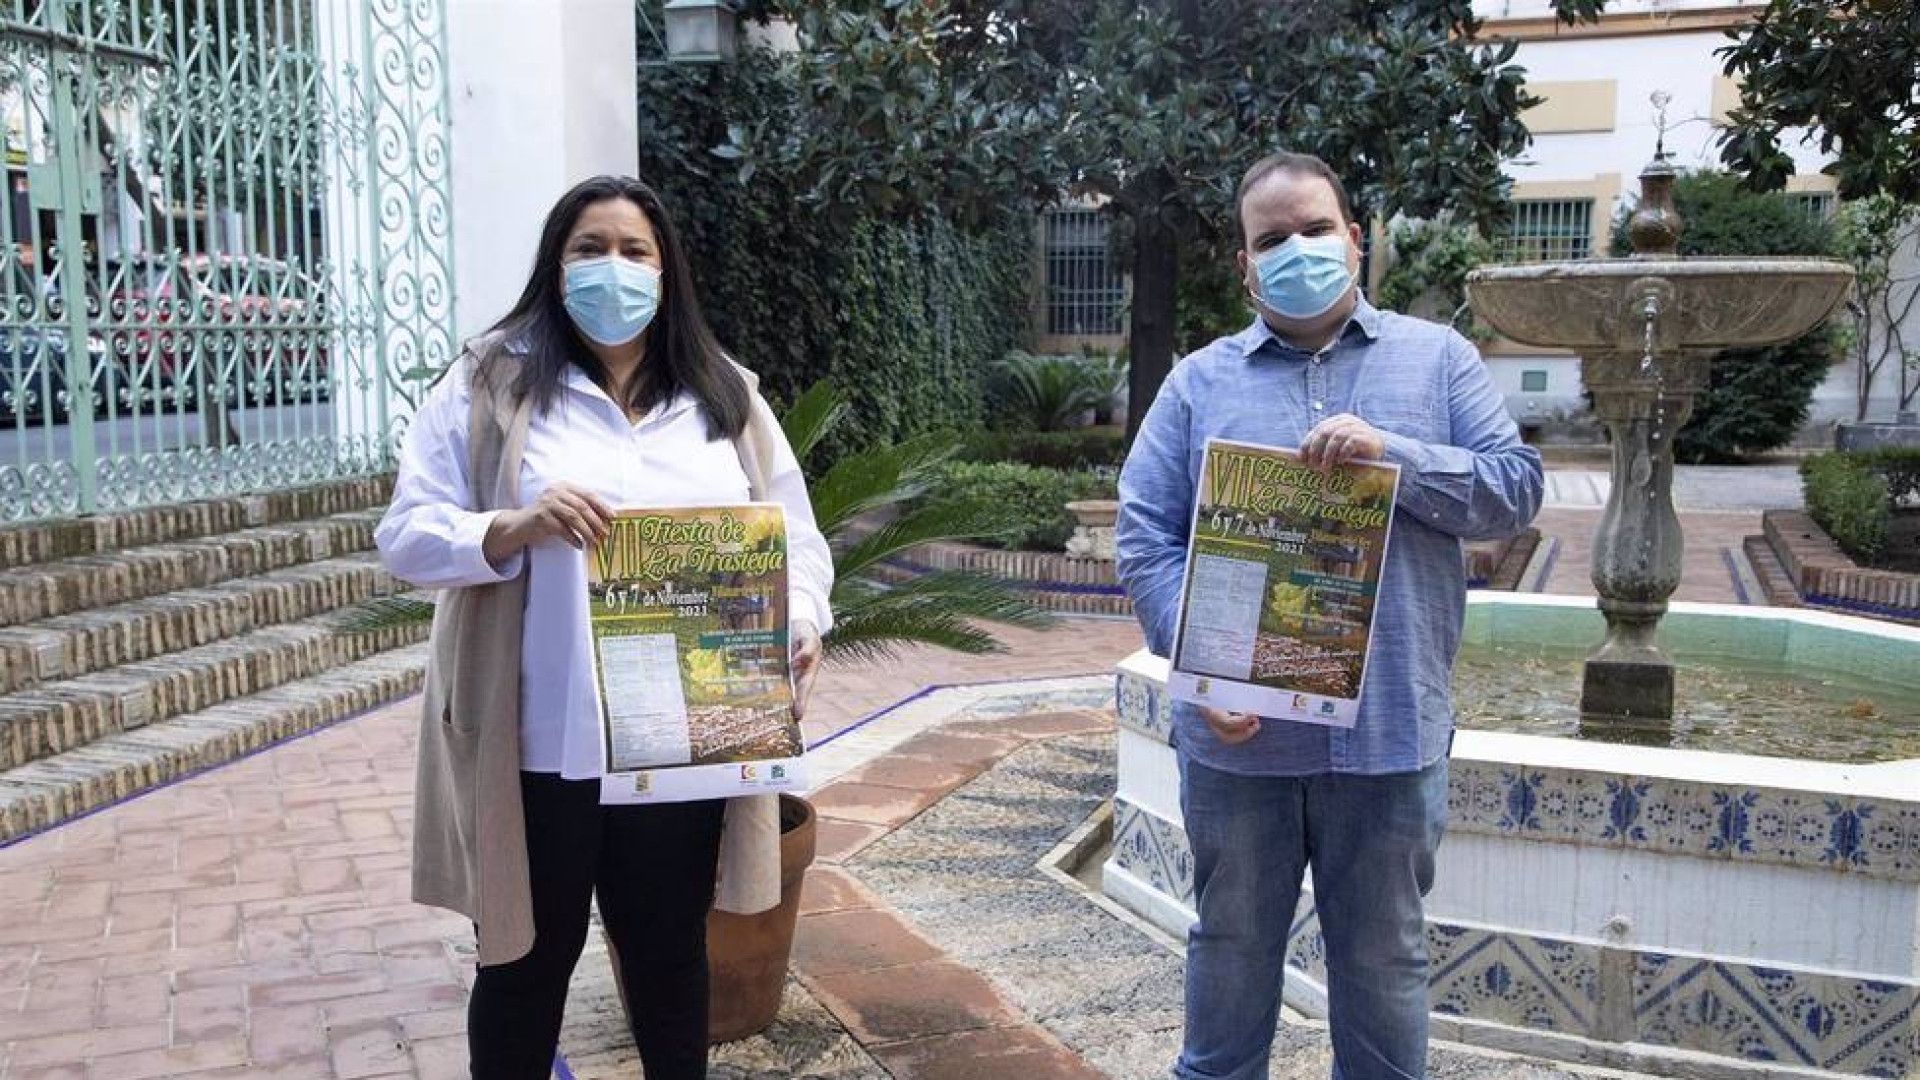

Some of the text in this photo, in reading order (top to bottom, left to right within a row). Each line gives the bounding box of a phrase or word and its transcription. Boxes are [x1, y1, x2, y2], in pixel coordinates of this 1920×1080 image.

[1211, 452, 1353, 509] VII Fiesta de
[1211, 509, 1221, 531] 6
[1223, 516, 1233, 538] y
[1236, 513, 1245, 534] 7
[1250, 487, 1386, 529] La Trasiega
[598, 510, 746, 580] VII Fiesta de
[1275, 542, 1303, 556] 2021
[640, 545, 784, 581] La Trasiega
[605, 583, 615, 609] 6
[618, 590, 628, 615] y
[630, 583, 640, 608] 7
[678, 605, 707, 617] 2021
